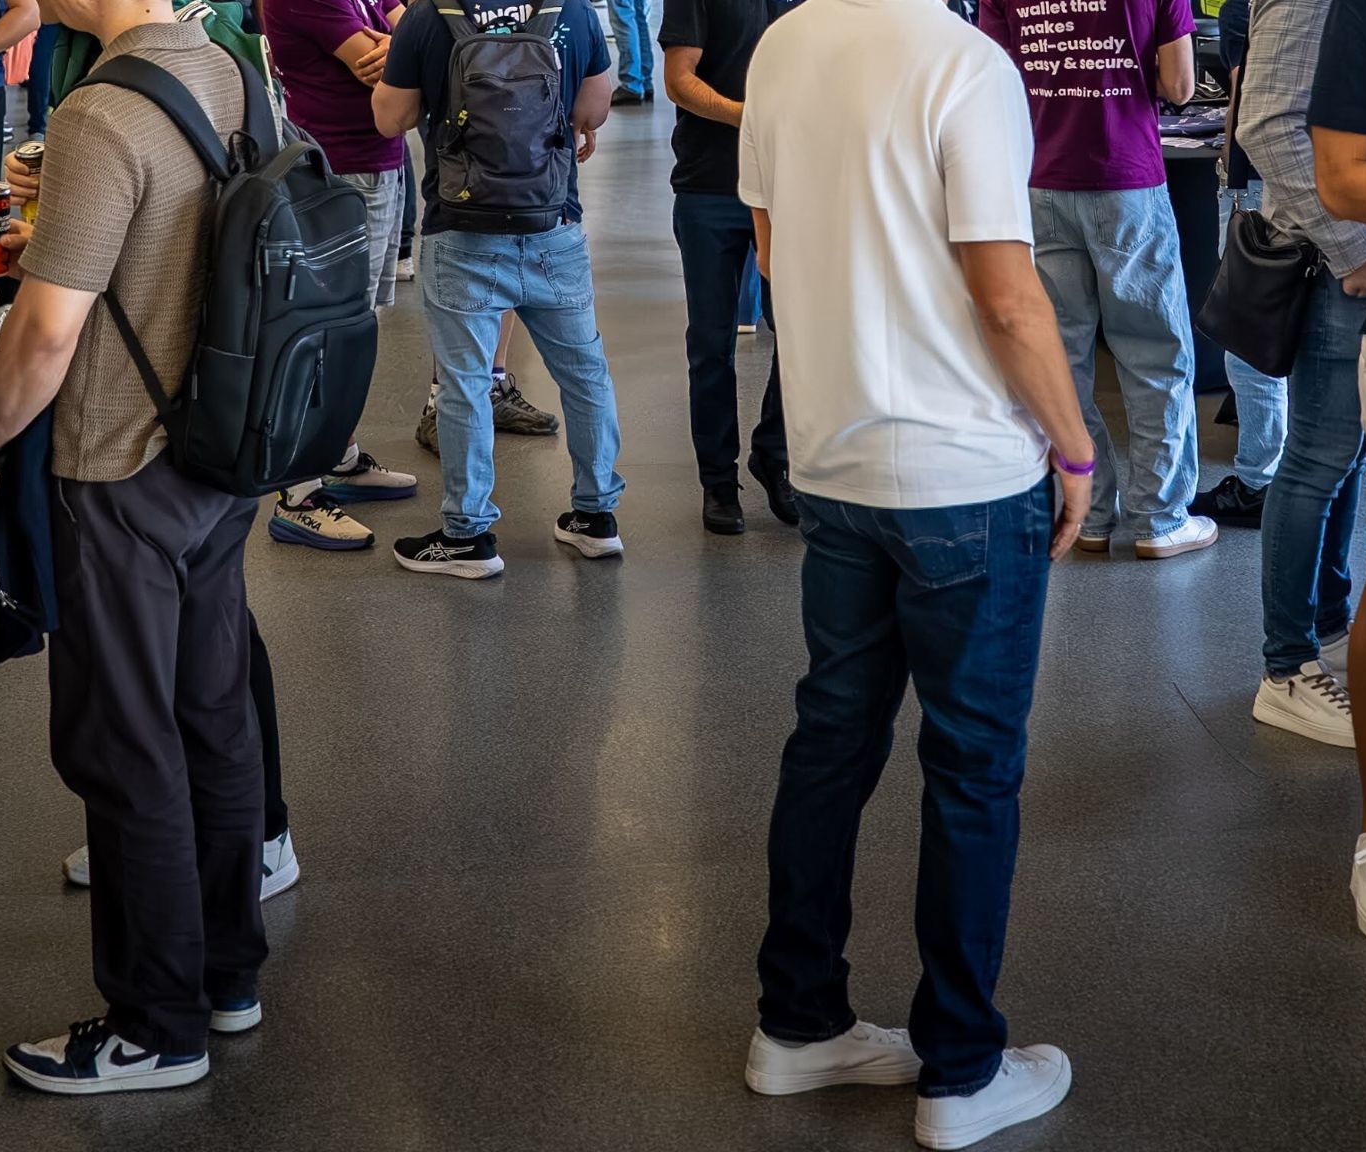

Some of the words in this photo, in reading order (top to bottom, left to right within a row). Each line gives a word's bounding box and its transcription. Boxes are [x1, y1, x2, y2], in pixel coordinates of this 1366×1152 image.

[1016, 0, 1068, 18] wallet
[1021, 20, 1075, 37] makes
[1020, 36, 1125, 54] self-custody
[1024, 59, 1060, 76] easy
[1063, 57, 1077, 70] &
[1079, 57, 1139, 70] secure.
[1029, 86, 1132, 98] www.ambire.com
[297, 512, 322, 531] HOKA
